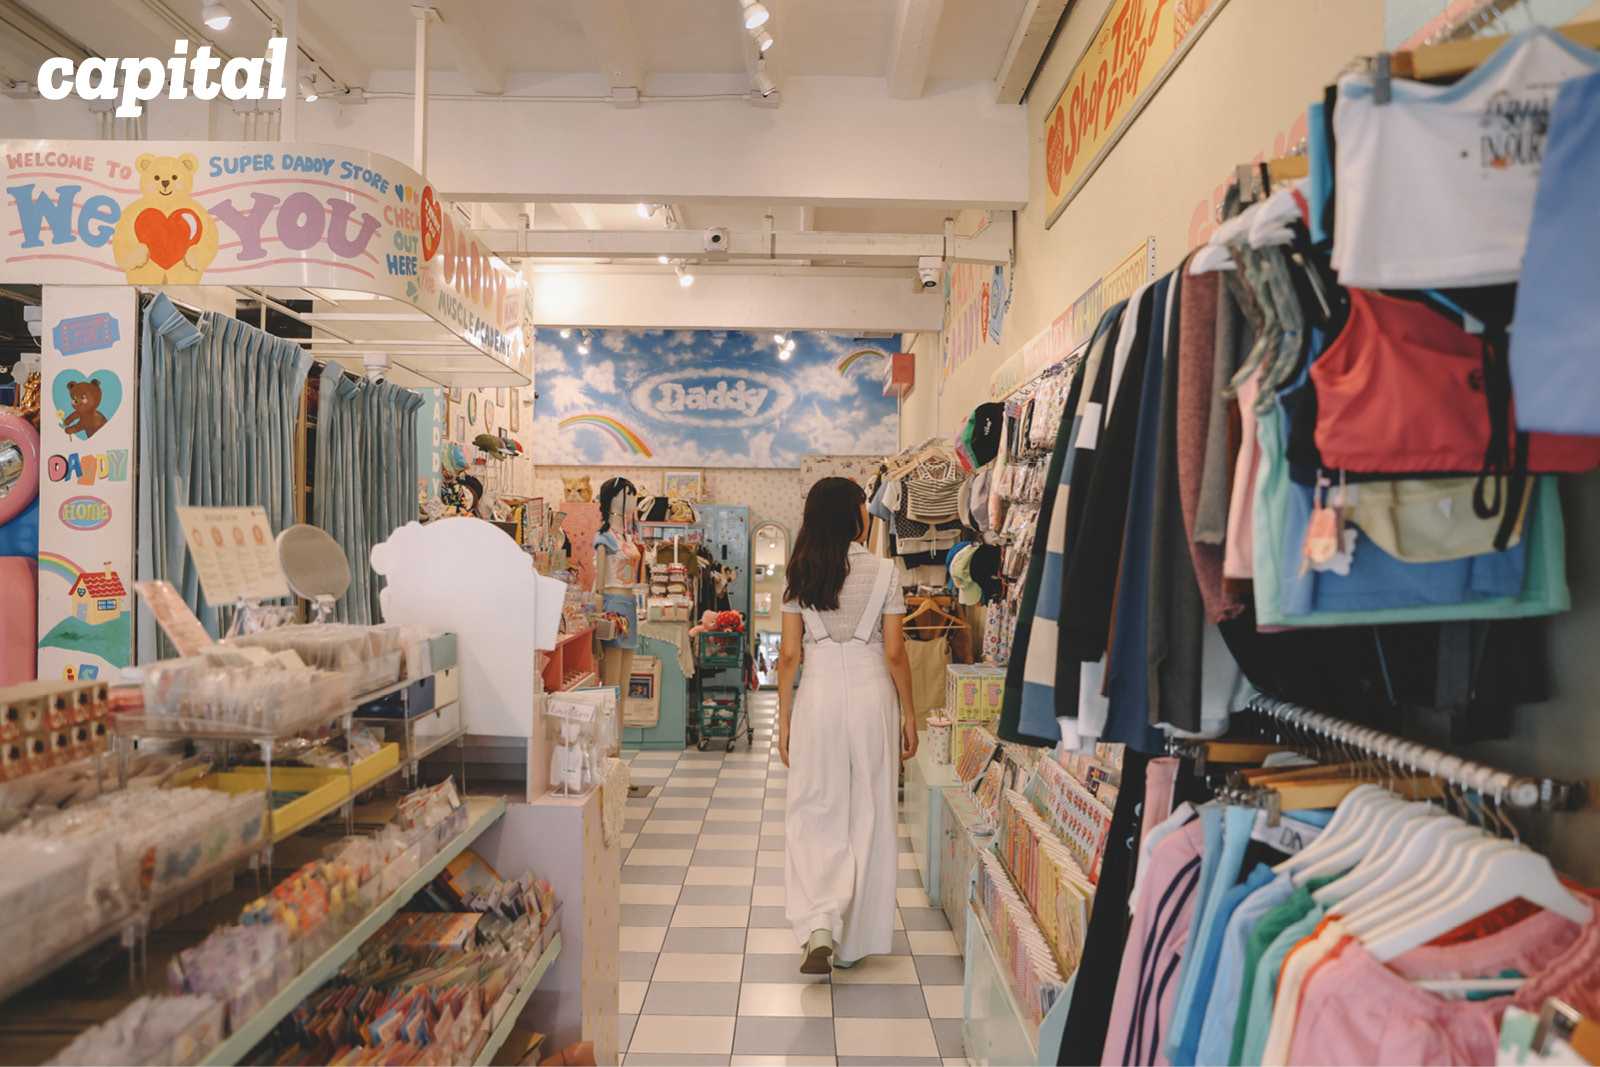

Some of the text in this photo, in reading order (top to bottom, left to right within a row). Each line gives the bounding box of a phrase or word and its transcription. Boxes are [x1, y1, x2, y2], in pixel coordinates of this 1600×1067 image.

[1103, 37, 1147, 132] Drop
[1063, 59, 1108, 177] Shop
[6, 152, 132, 180] WELCOME TO
[209, 153, 390, 195] SUPER DADDY STORE
[6, 183, 122, 249] We
[207, 191, 382, 261] YOU
[383, 205, 422, 232] CHECK
[393, 230, 419, 254] OUT
[386, 253, 418, 277] HERE
[419, 265, 436, 295] The
[443, 211, 507, 328] DADDY
[73, 334, 99, 346] CLUB
[437, 290, 511, 357] MUSCLE ACADEMY
[655, 380, 768, 417] Daddy
